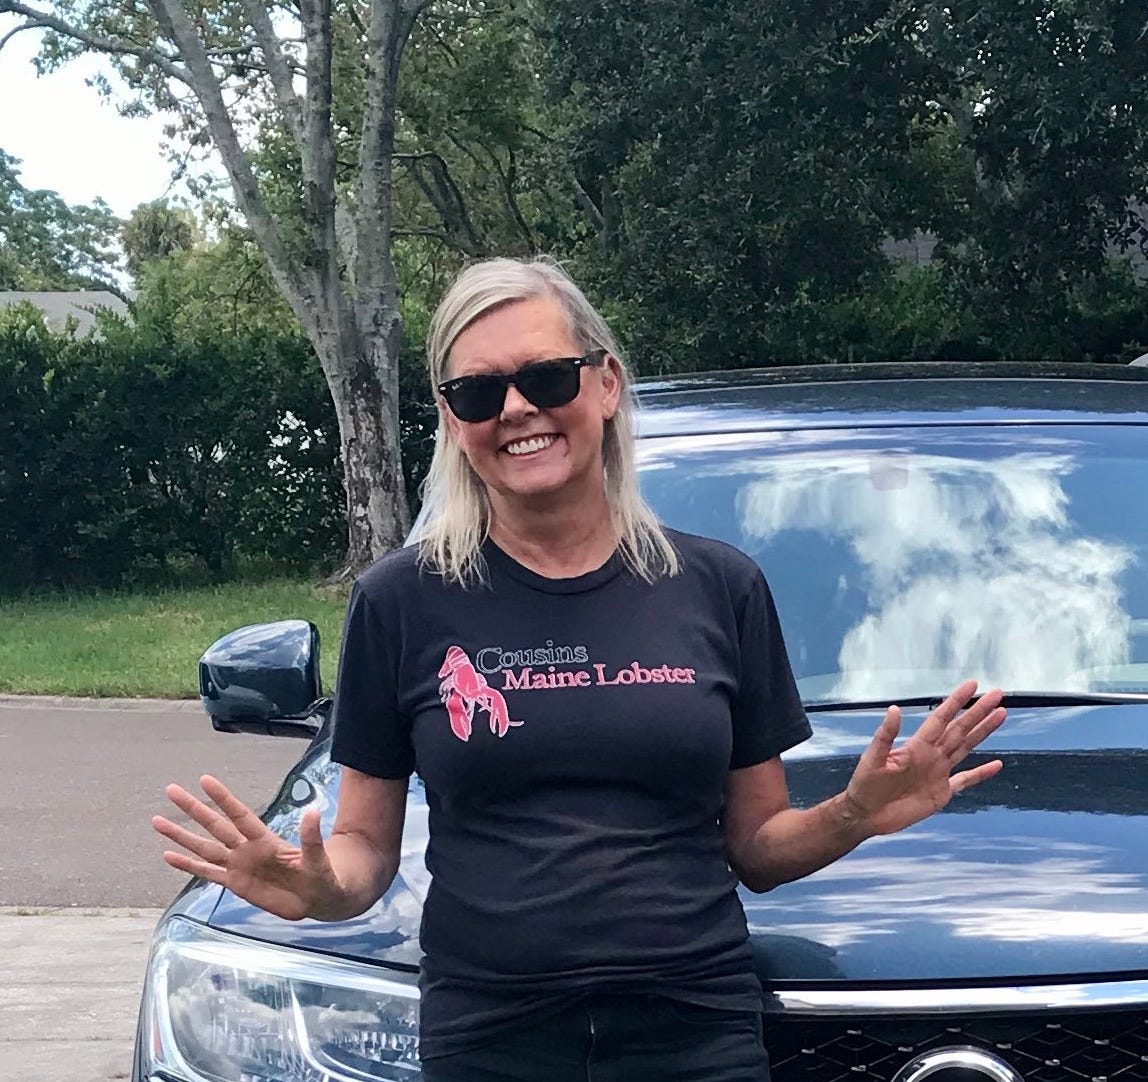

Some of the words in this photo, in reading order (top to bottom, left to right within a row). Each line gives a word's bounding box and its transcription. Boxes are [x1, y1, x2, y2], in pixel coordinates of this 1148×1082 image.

[476, 640, 588, 674] Cousins
[503, 666, 591, 690] Maine
[594, 662, 695, 686] Lobster
